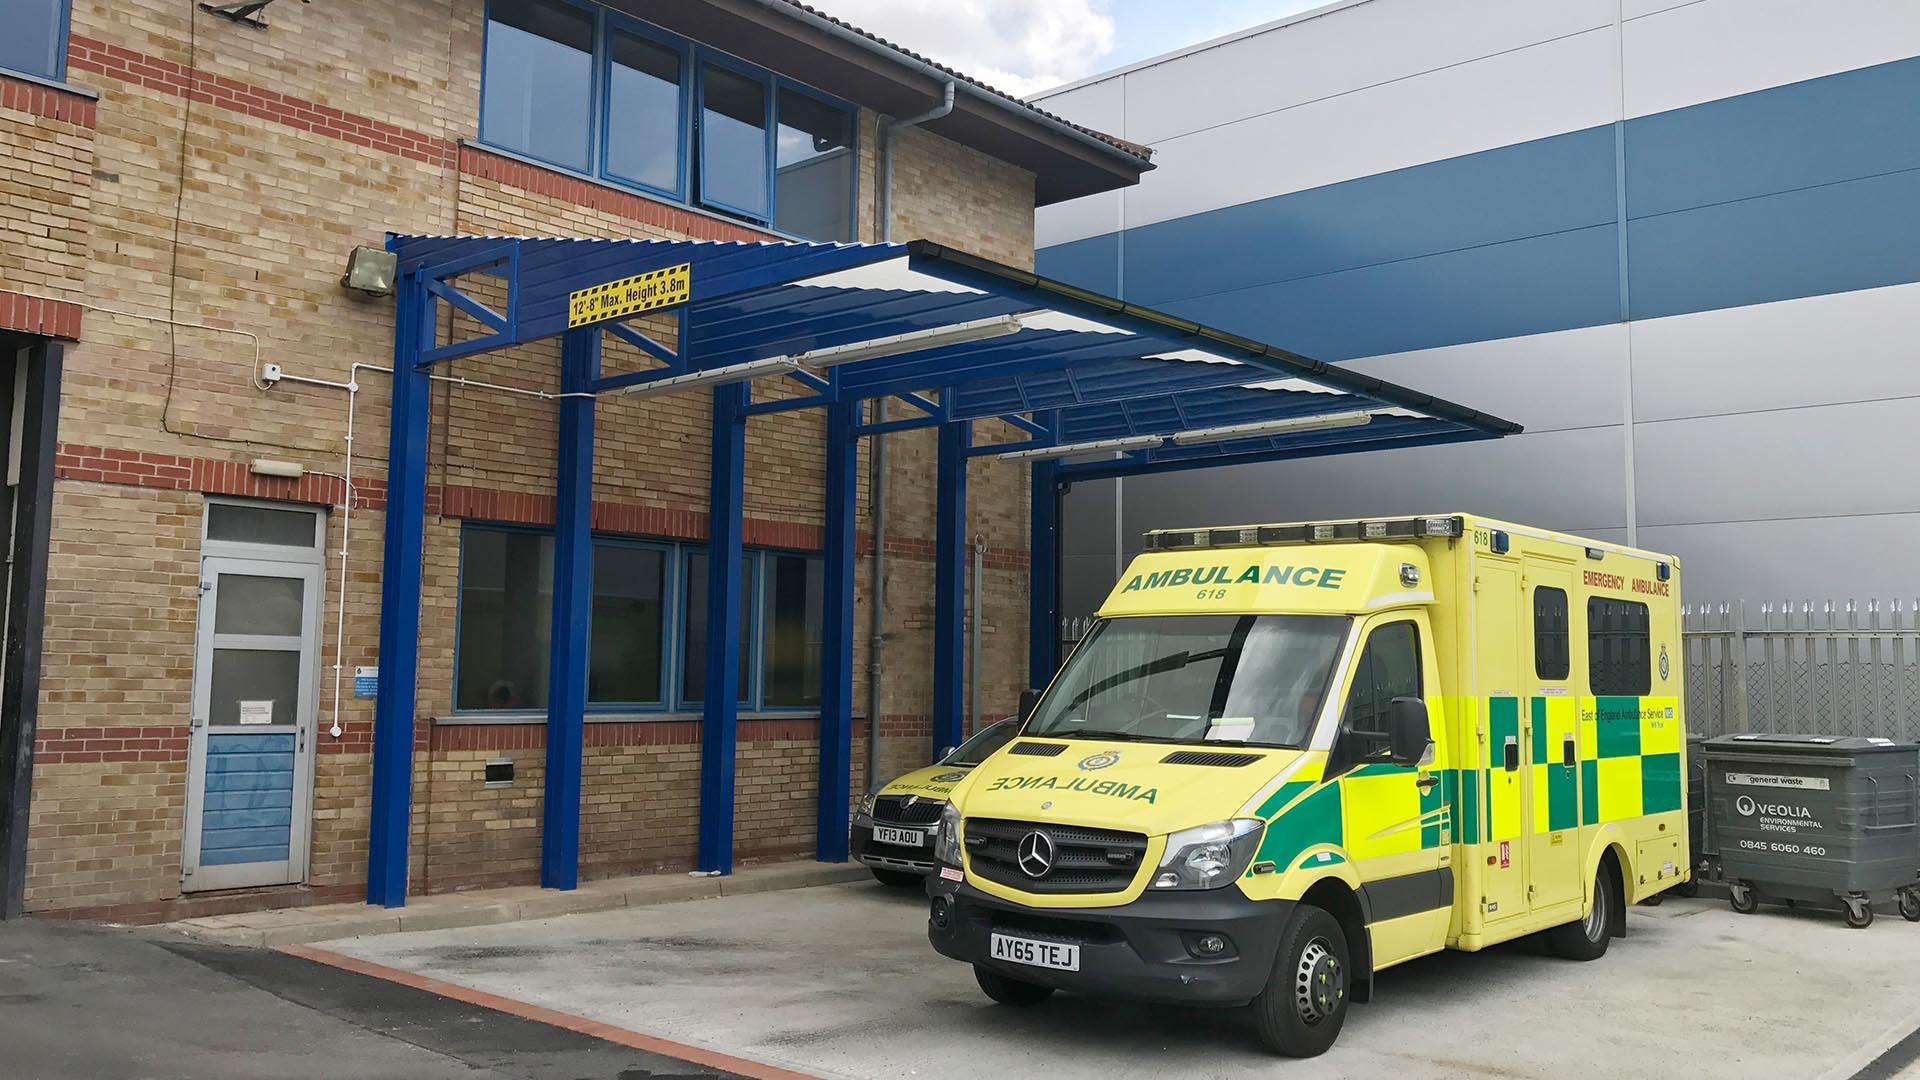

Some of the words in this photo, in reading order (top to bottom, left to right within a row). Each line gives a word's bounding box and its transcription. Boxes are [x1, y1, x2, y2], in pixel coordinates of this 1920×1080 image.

[600, 294, 622, 309] Max.
[625, 284, 658, 303] Height
[659, 278, 685, 295] 3.8m
[1474, 530, 1488, 546] 618
[1120, 565, 1347, 595] AMBULANCE
[1583, 570, 1626, 591] EMERGENCY
[1631, 579, 1670, 597] AMBULANCE
[1195, 589, 1227, 600] 618
[1581, 709, 1593, 721] East
[1621, 708, 1646, 721] Ambulance
[1647, 708, 1664, 720] Service
[1749, 776, 1779, 784] general
[1780, 777, 1803, 785] waste
[1757, 803, 1811, 818] VEOLIA
[1760, 817, 1823, 828] ENVIRONMENTAL
[1760, 824, 1797, 833] SERVICES
[878, 828, 897, 841] YF13
[899, 831, 917, 844] AOU
[1740, 840, 1767, 850] 0845
[1770, 841, 1800, 854] 6060
[1803, 845, 1826, 856] 460
[996, 937, 1034, 962] AY65
[1039, 944, 1072, 967] TEJ
